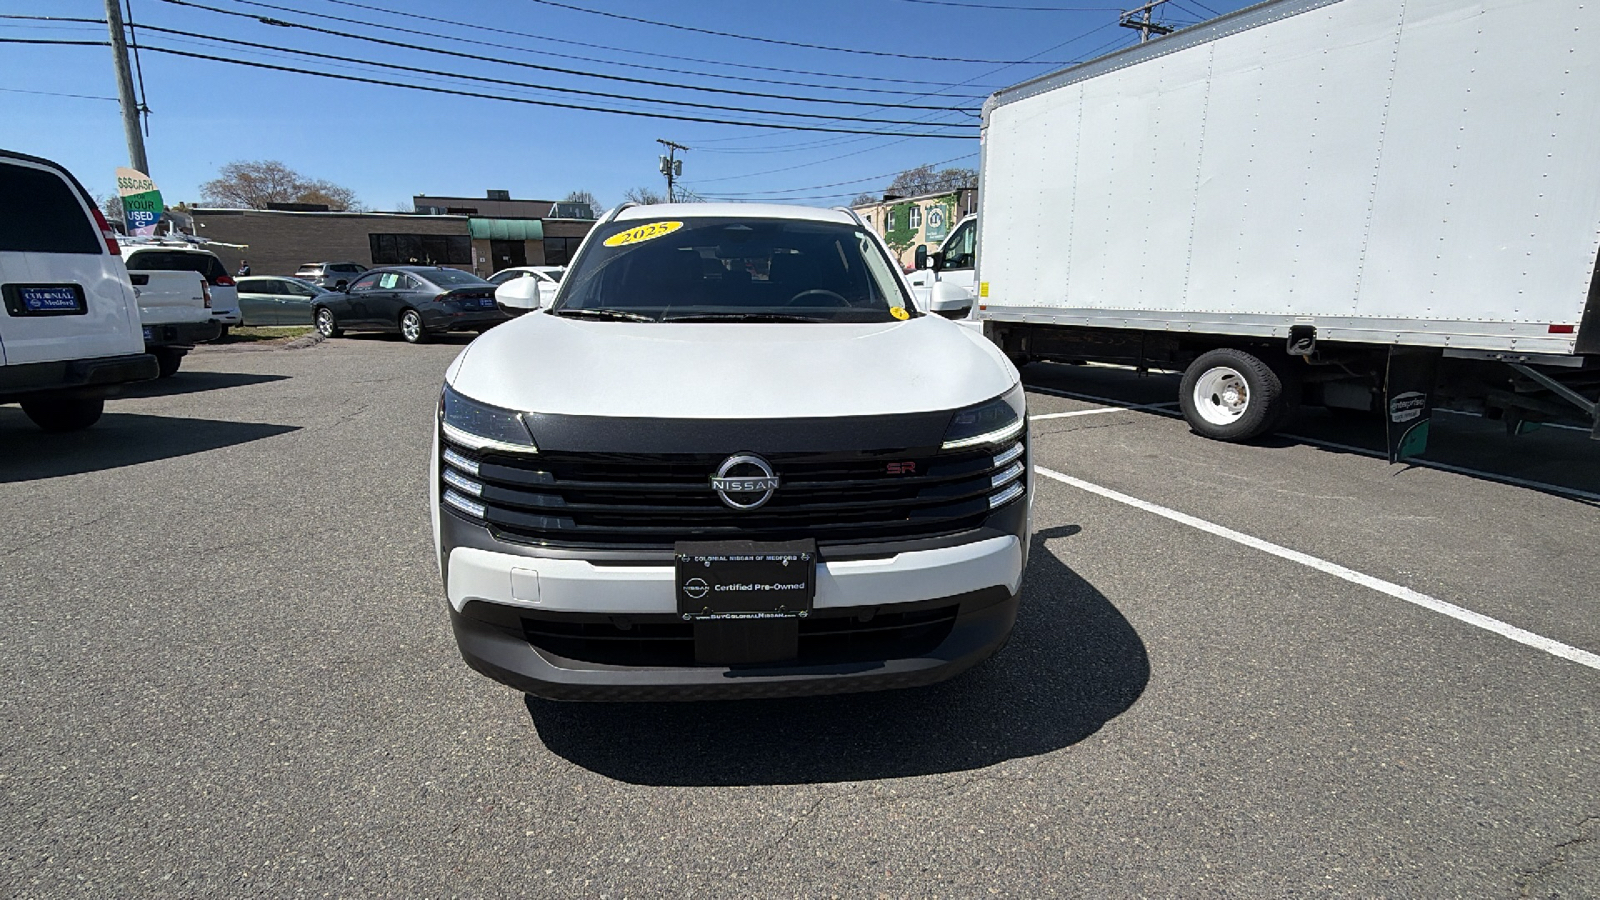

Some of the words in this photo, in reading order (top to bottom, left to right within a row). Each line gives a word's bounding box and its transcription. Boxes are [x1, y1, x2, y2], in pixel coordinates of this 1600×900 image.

[128, 201, 154, 209] YOUR
[127, 211, 154, 220] USED
[621, 223, 669, 243] 2025
[886, 462, 916, 474] SR
[713, 479, 778, 491] NISSAN
[714, 583, 753, 591] Certified
[754, 582, 805, 591] Pre-Owned
